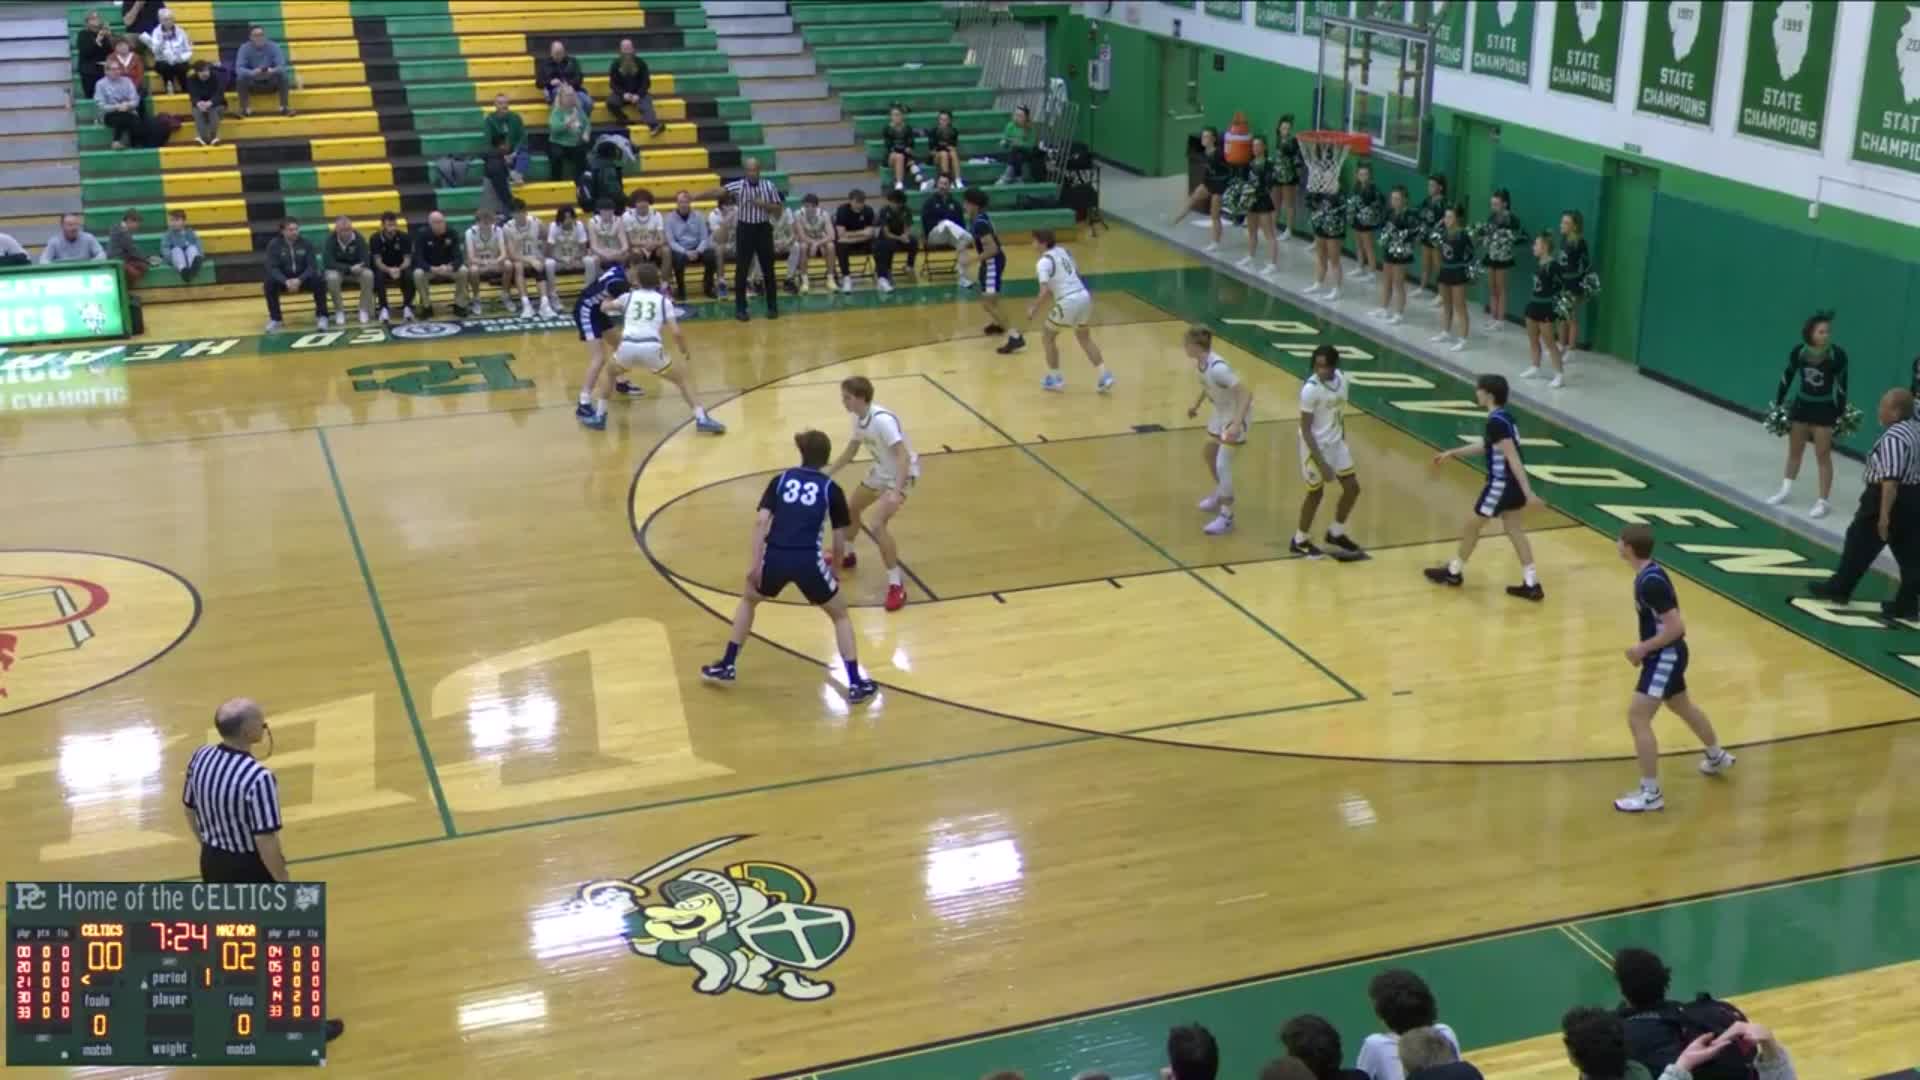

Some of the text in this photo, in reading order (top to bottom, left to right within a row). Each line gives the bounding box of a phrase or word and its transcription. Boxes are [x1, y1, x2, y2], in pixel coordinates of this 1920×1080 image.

[1487, 34, 1516, 52] STATE
[1474, 53, 1526, 77] CHAMPIONS
[1567, 50, 1599, 68] STATE
[1552, 67, 1612, 93] CHAMPIONS
[1660, 67, 1694, 90] STATE
[1643, 88, 1706, 118] CHAMPIONS
[1763, 88, 1802, 111] STATE
[1744, 108, 1816, 139] CHAMPIONS
[632, 302, 657, 320] 33
[783, 479, 819, 505] 33
